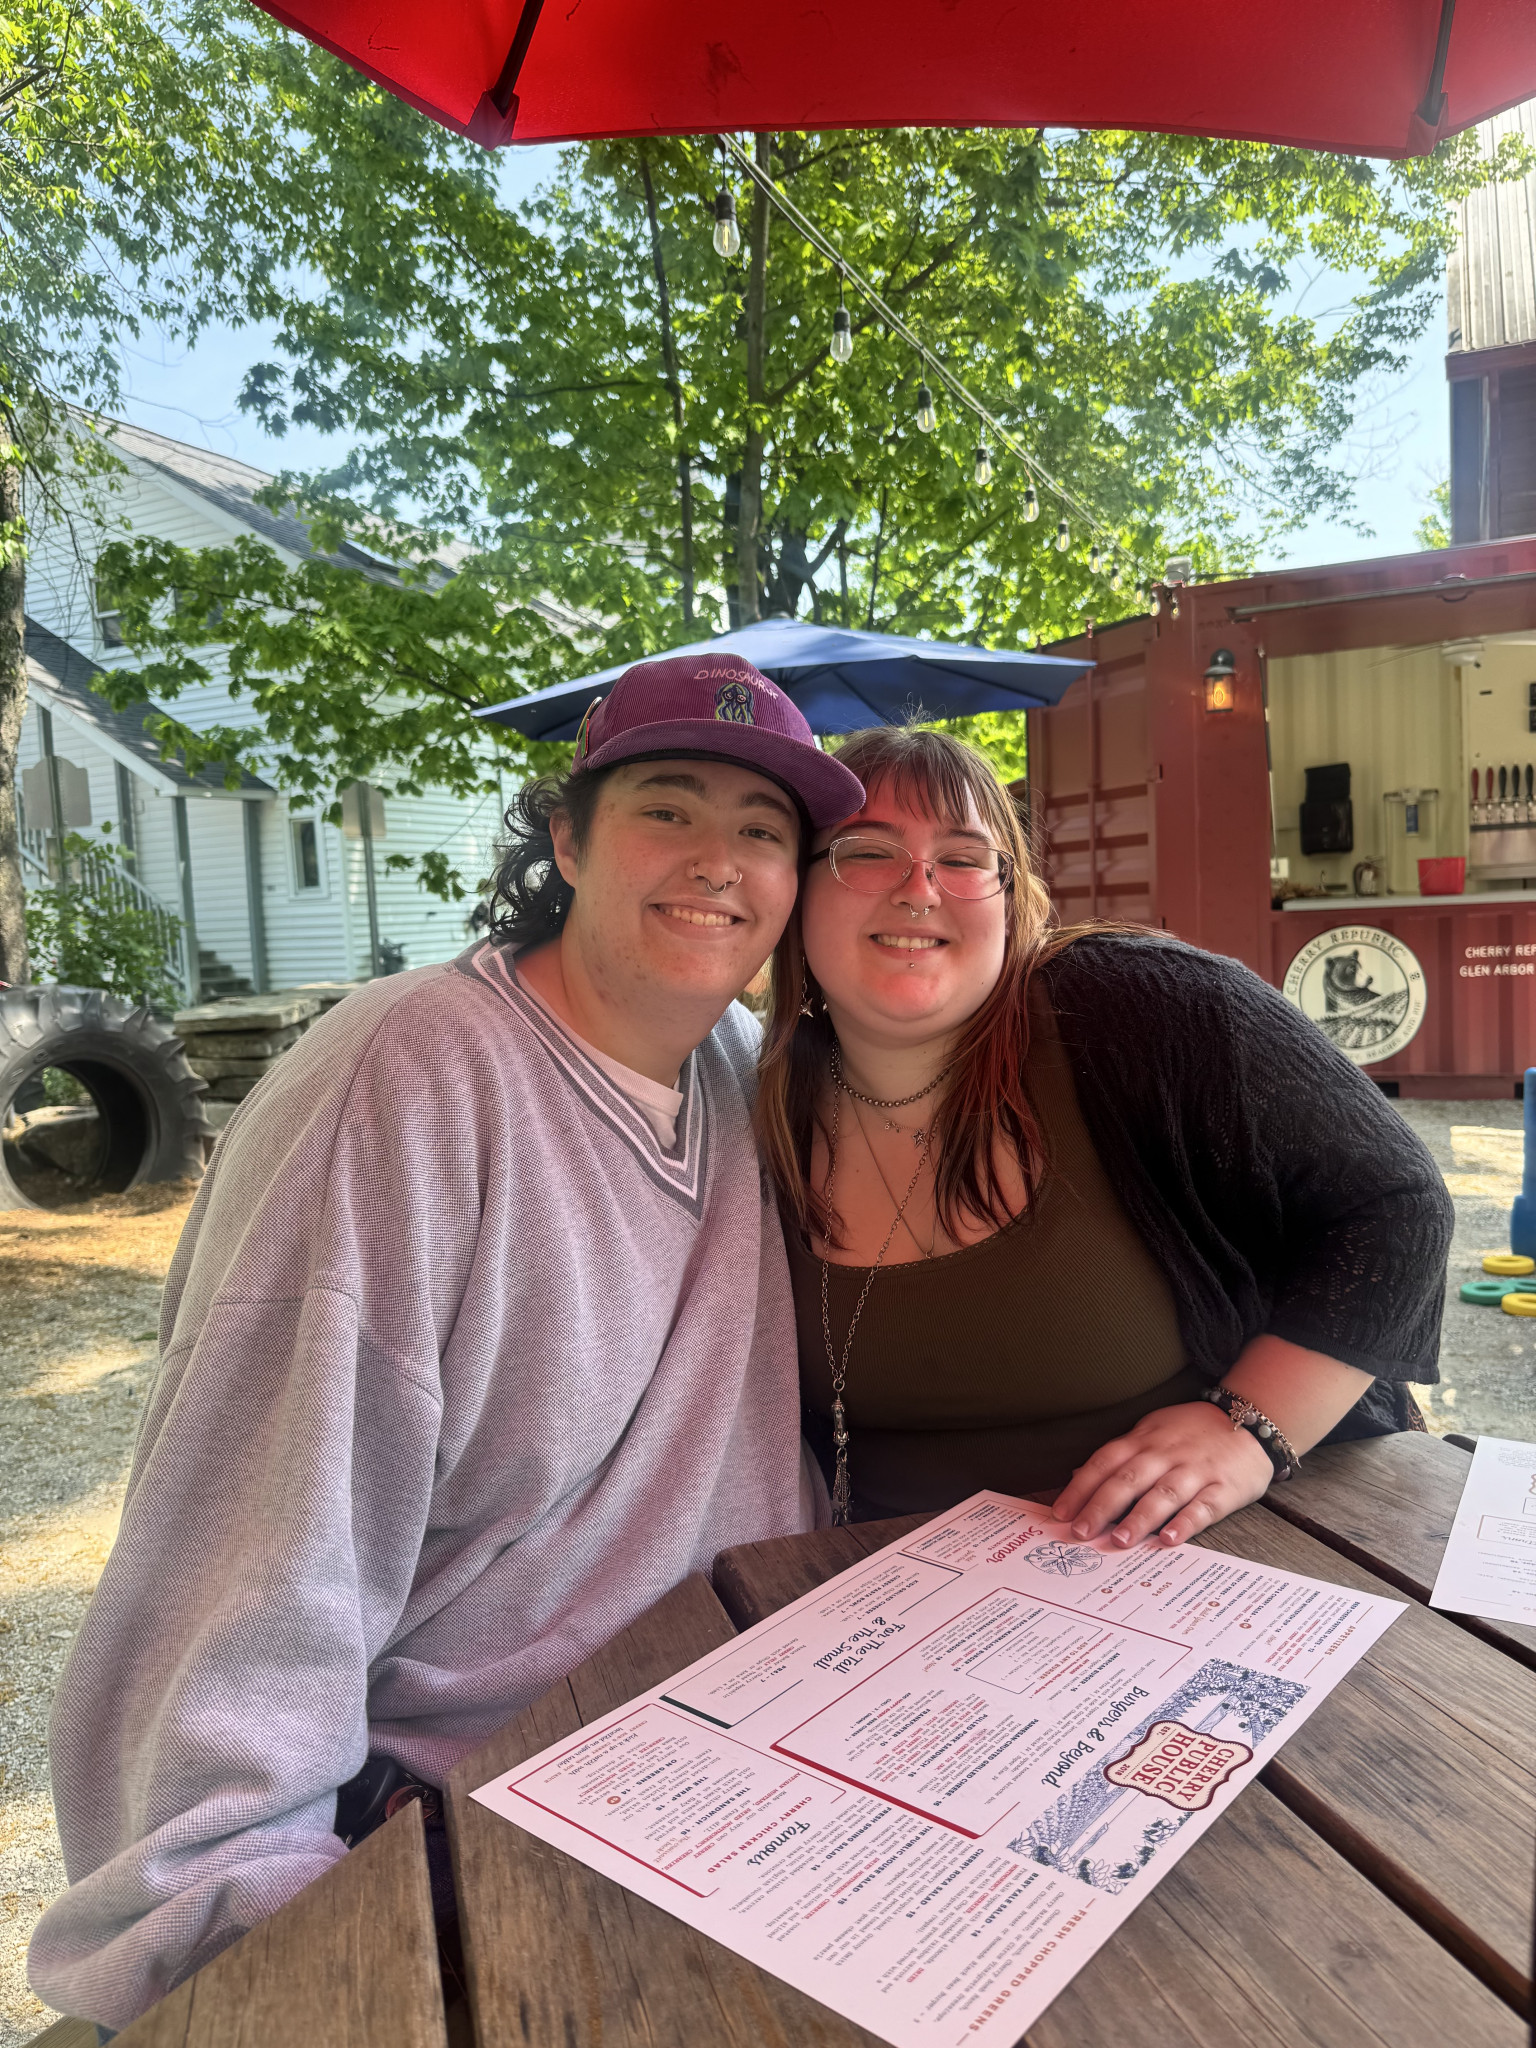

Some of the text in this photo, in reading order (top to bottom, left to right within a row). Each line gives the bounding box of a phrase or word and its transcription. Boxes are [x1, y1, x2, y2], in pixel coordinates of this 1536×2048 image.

[693, 669, 765, 691] DINOSAUR
[1287, 928, 1407, 996] CHERRY REPUBLIC
[1465, 945, 1511, 959] CHERRY
[1459, 963, 1535, 977] GLEN ARBOR
[979, 1525, 1047, 1564] Summer
[843, 1625, 878, 1644] The
[1323, 1625, 1357, 1655] APPETIZERS
[808, 1642, 858, 1670] Small
[828, 1621, 908, 1675] For The Tall
[1087, 1684, 1152, 1730] Burgers
[890, 1708, 931, 1737] FRANKFURTER
[964, 1713, 989, 1730] PULLED
[949, 1729, 968, 1743] PORK
[1083, 1727, 1110, 1742] &
[918, 1742, 953, 1768] SANDWICH
[1029, 1738, 1101, 1790] Beyond
[1129, 1731, 1196, 1786] HOUSE
[634, 1765, 666, 1786] GREENS
[964, 1759, 990, 1779] GRILLED
[1113, 1763, 1130, 1776] 2018
[1153, 1739, 1218, 1794] PUBLIC
[1174, 1746, 1236, 1802] CHERRY
[691, 1775, 709, 1786] THE
[943, 1777, 969, 1797] CHEESE
[668, 1785, 694, 1801] WRAP
[733, 1786, 751, 1797] THE
[693, 1796, 736, 1825] SANDWICH
[868, 1806, 893, 1823] FRESH
[705, 1795, 813, 1874] CHERRY CHICKEN SALAD
[845, 1822, 872, 1842] SPRING
[916, 1824, 934, 1836] THE
[742, 1818, 812, 1869] Famous
[823, 1841, 849, 1860] SALAD
[894, 1834, 921, 1856] PUBLIC
[872, 1854, 899, 1875] HOUSE
[957, 1847, 985, 1870] CHERRY
[850, 1872, 876, 1893] SALAD
[939, 1869, 961, 1887] ROKA
[1018, 1871, 1040, 1889] BABY
[917, 1885, 943, 1906] SALAD
[1002, 1887, 1024, 1904] KALE
[982, 1902, 1008, 1925] SALAD
[966, 1908, 1087, 2033] FRESH CHOPPED GREENS
